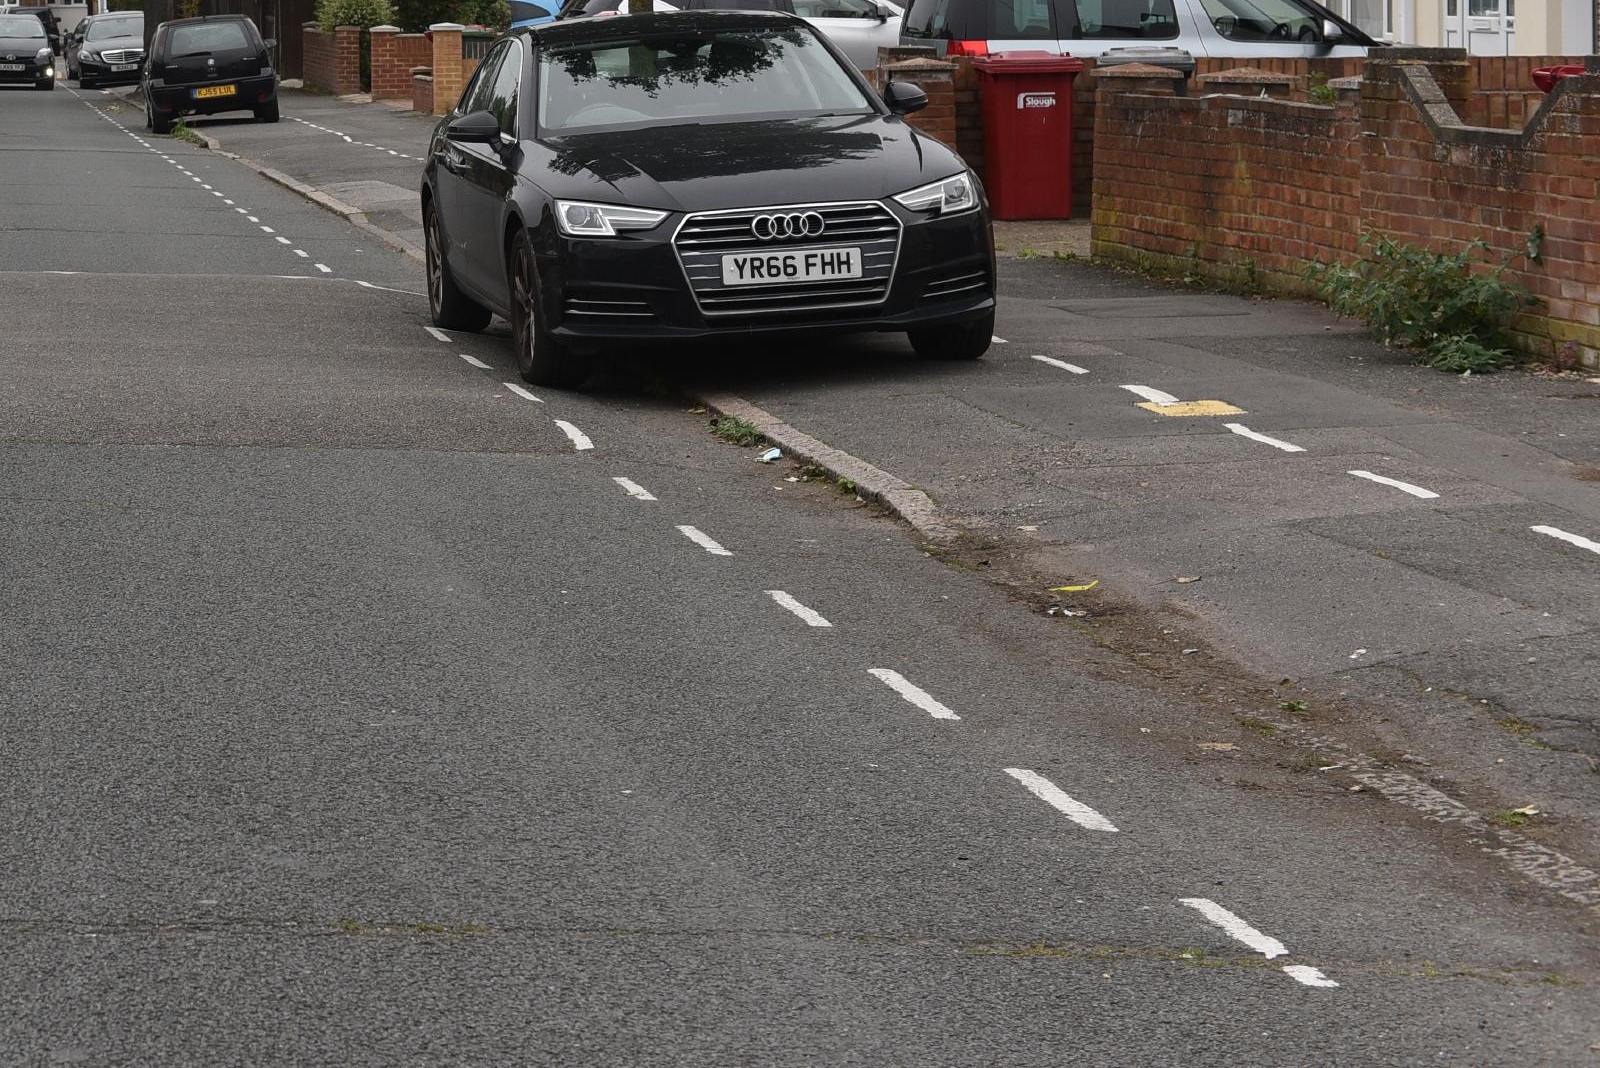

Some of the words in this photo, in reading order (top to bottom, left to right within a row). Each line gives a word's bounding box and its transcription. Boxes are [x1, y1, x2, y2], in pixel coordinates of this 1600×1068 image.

[219, 85, 234, 94] LUL
[1025, 96, 1056, 107] Slough
[733, 256, 798, 280] YR66
[804, 251, 851, 276] FHH
